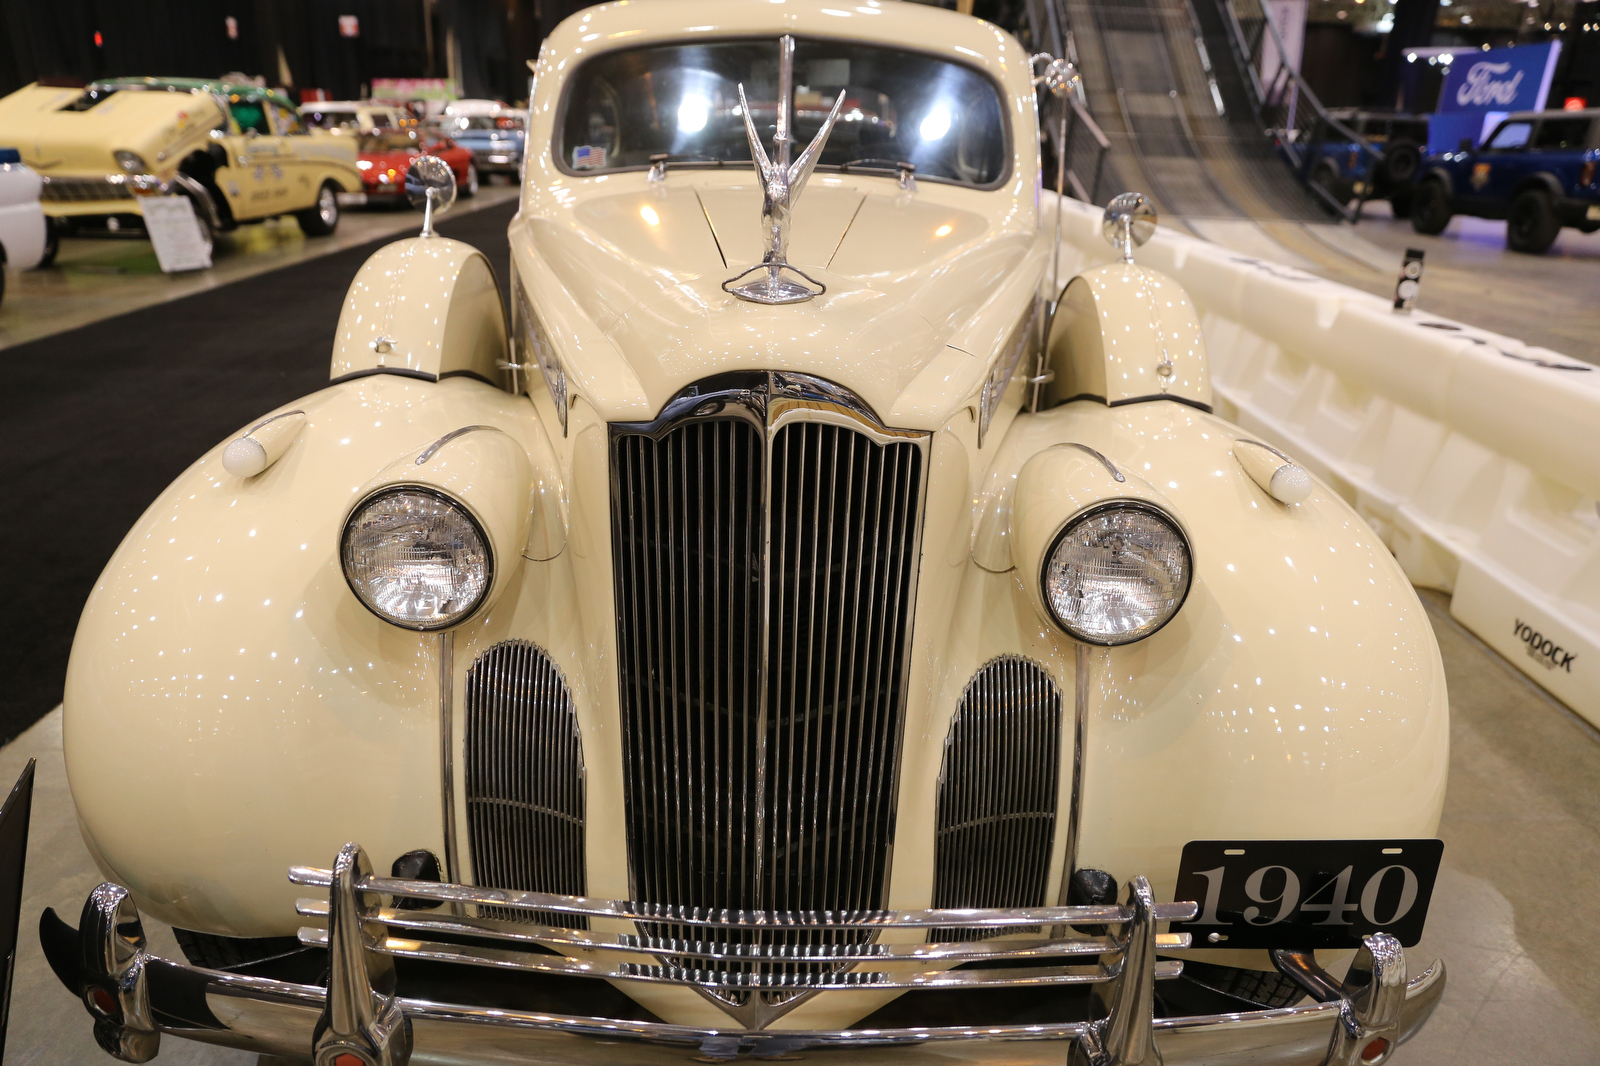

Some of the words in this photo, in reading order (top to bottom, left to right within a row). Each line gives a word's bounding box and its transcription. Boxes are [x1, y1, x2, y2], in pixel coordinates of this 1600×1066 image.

[1456, 61, 1525, 106] Ford
[1513, 618, 1578, 673] YODOCK
[1181, 864, 1419, 926] 1940
